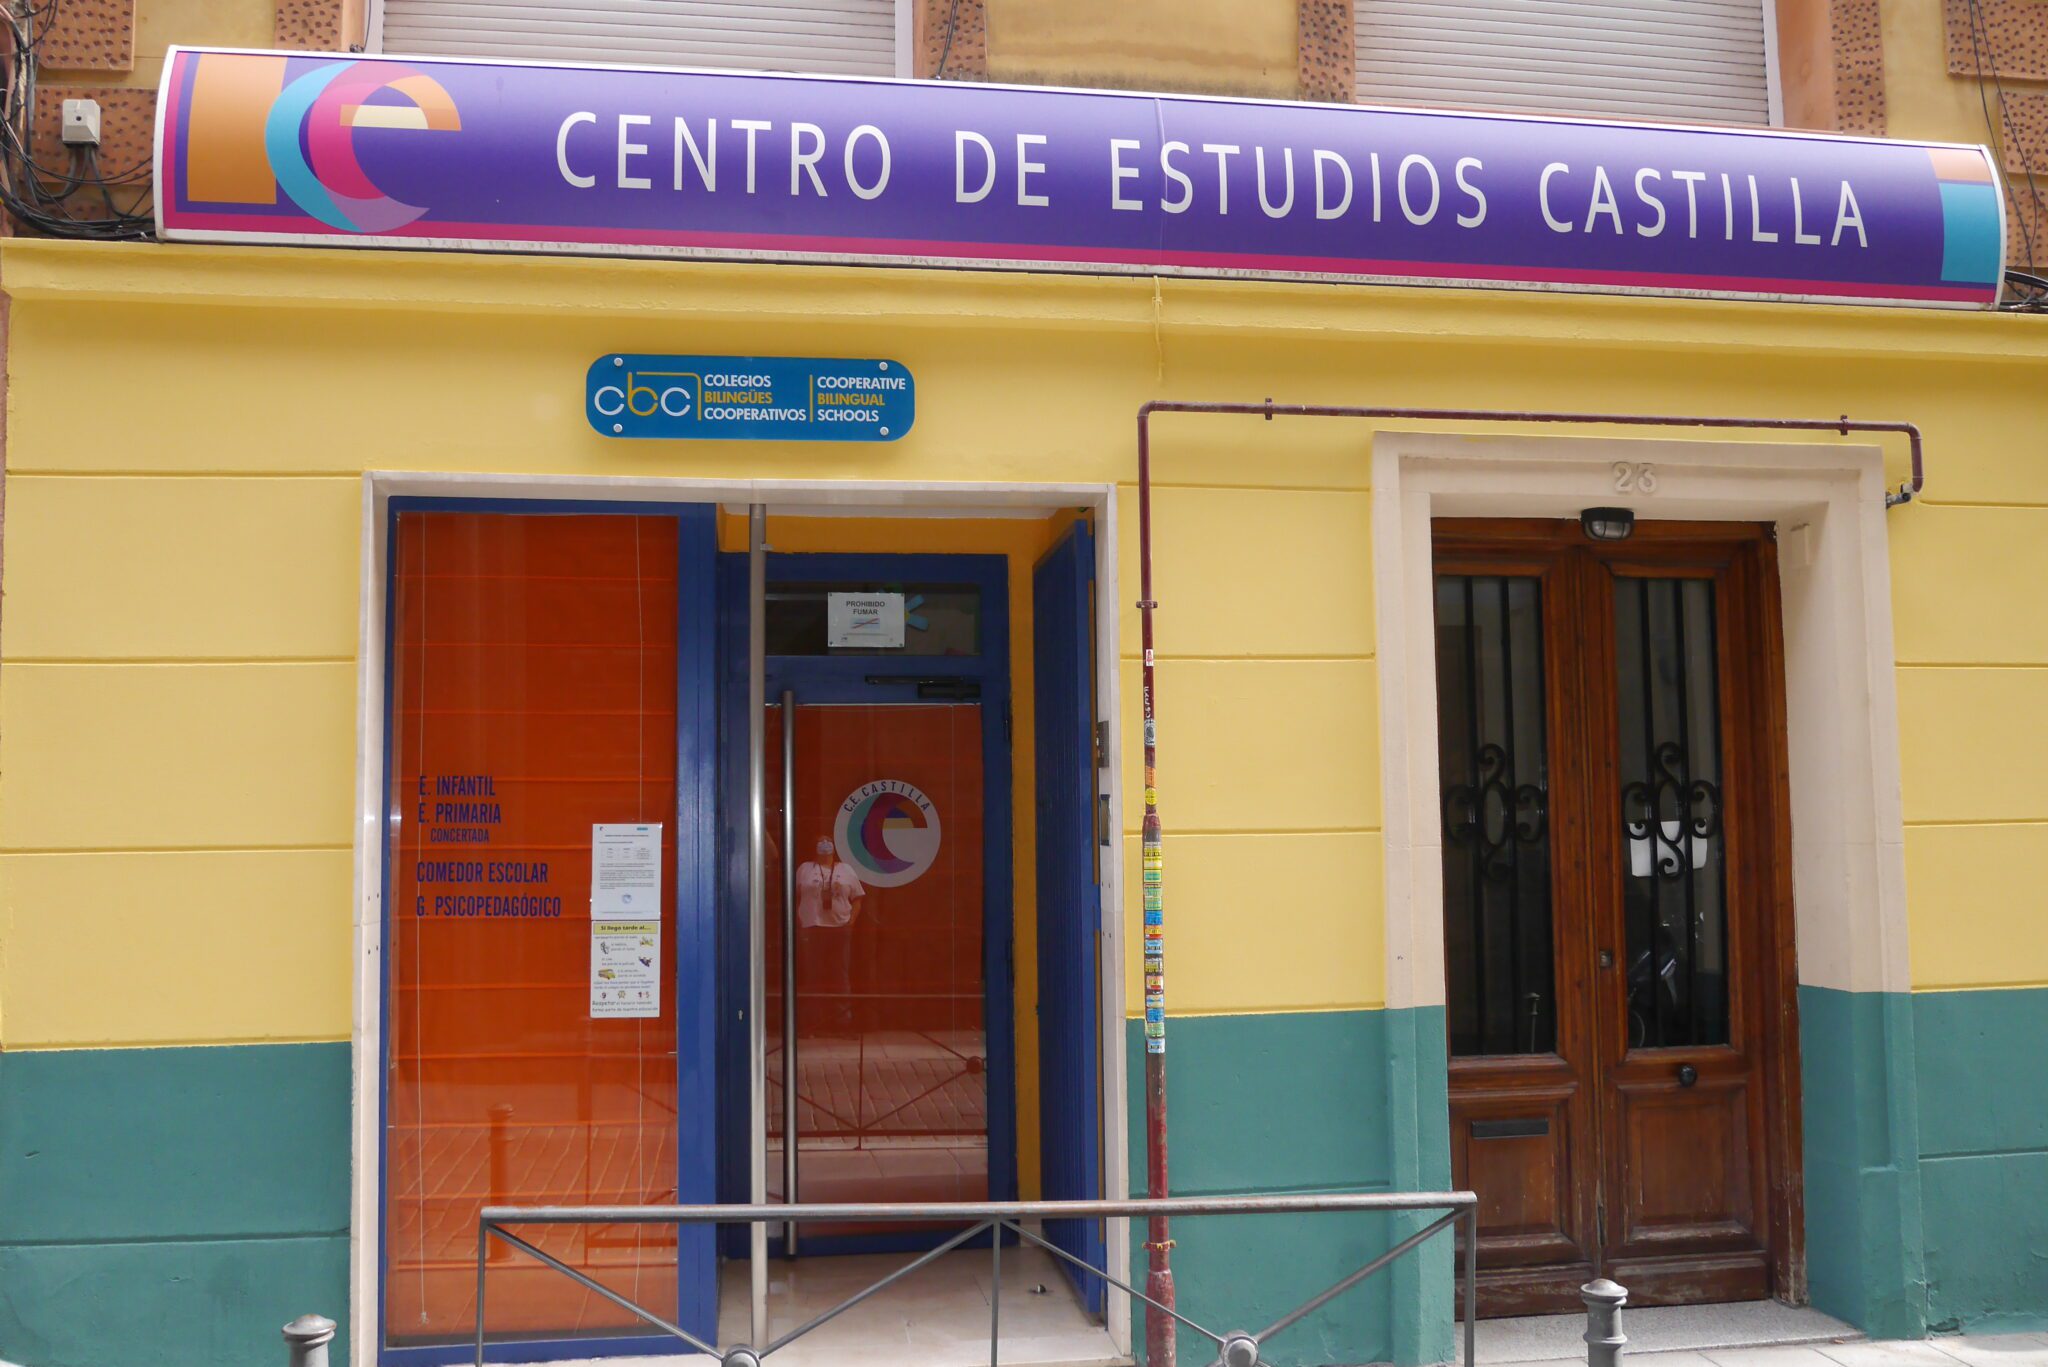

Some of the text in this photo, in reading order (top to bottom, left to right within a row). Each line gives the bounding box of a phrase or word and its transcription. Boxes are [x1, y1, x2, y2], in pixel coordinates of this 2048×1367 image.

[556, 111, 1869, 249] CENTRO DE ESTUDIOS CASTILLA
[703, 373, 772, 388] COLEGIOS
[816, 376, 906, 391] COOPERATIVE
[593, 371, 691, 417] cbc
[703, 389, 773, 405] BILINGÜES
[816, 392, 885, 407] BILINGUAL
[703, 407, 807, 422] COOPERATIVOS
[816, 408, 880, 423] SCHOOLS
[845, 600, 886, 608] PROHIBIDO
[852, 608, 879, 616] FUMAR
[418, 775, 496, 797] E. INFANTIL
[861, 781, 931, 812] CASTILLA
[417, 802, 502, 824] E. PRIMARIA
[430, 827, 490, 843] CONCERTADA
[416, 861, 549, 884] COMEDOR ESCOLAR
[416, 893, 562, 918] G. PSICOPEDAGÓGICO
